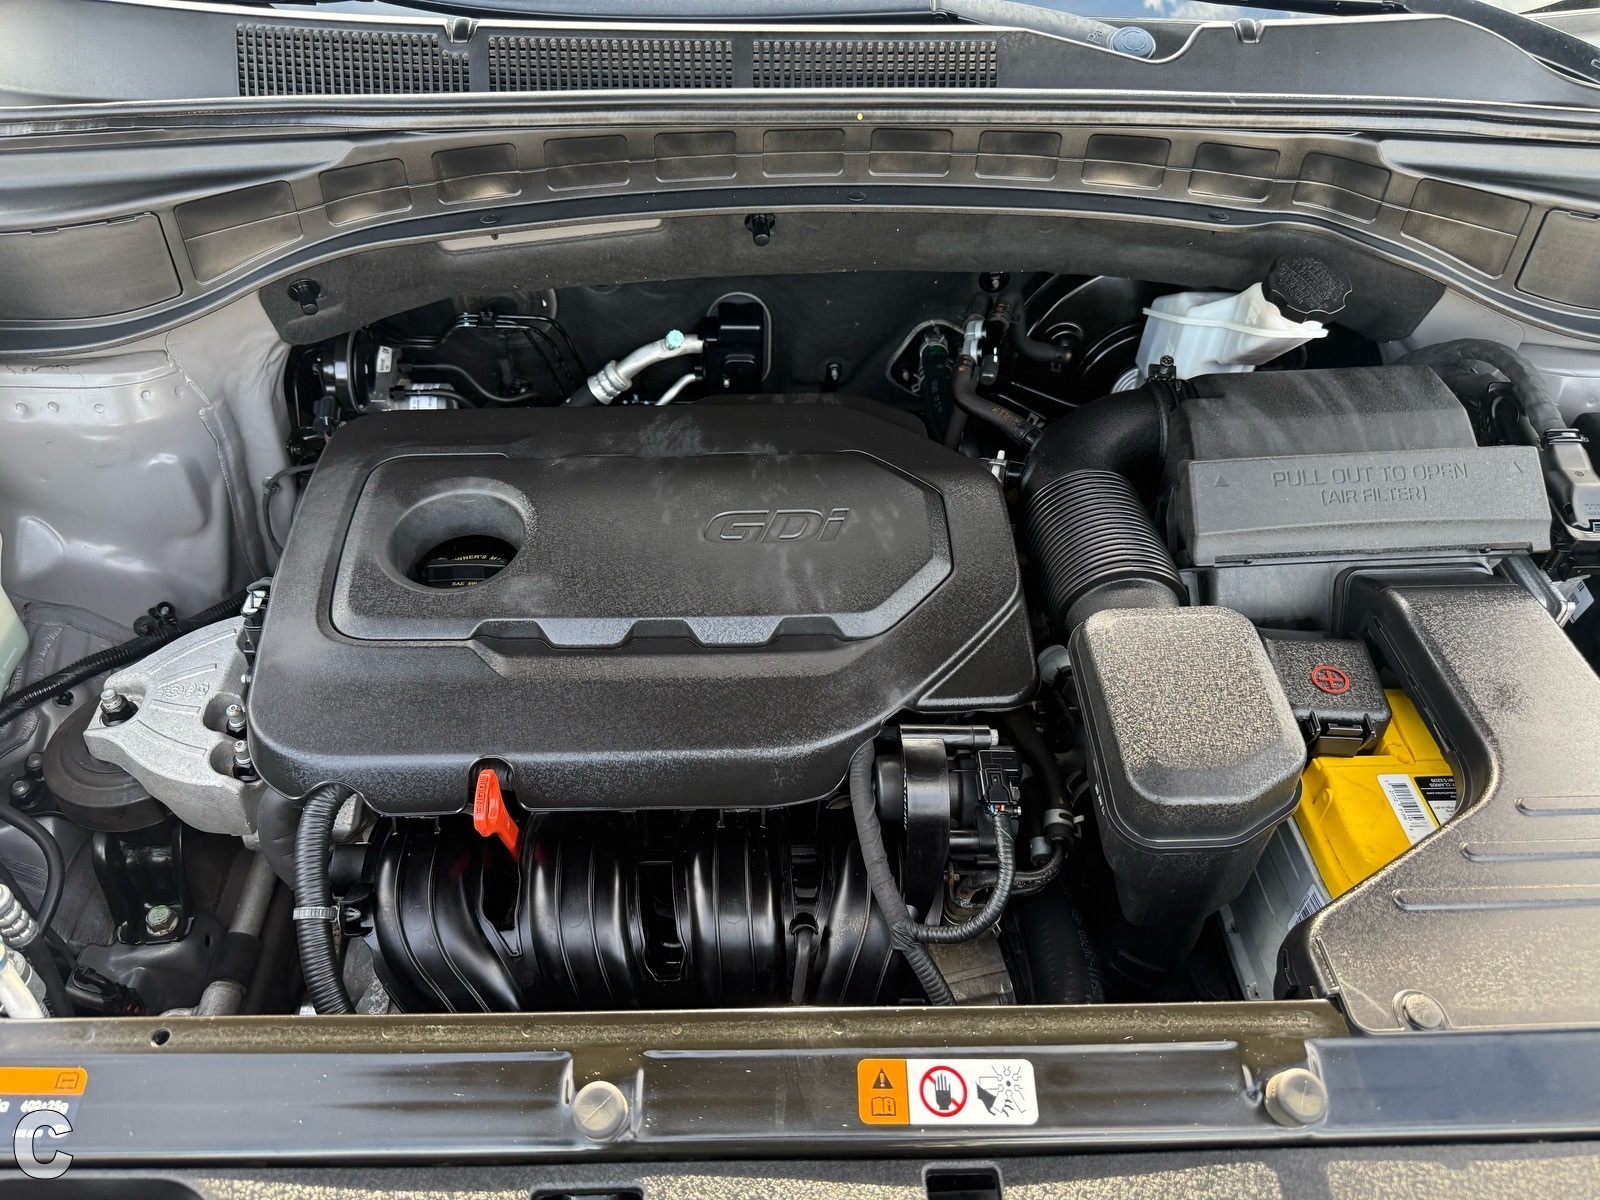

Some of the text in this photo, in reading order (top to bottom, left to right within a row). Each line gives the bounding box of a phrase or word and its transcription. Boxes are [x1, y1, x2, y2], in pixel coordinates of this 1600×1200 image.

[1272, 462, 1468, 487] PULL OUT TO OPEN
[703, 507, 850, 543] GDi
[476, 792, 486, 814] ENG
